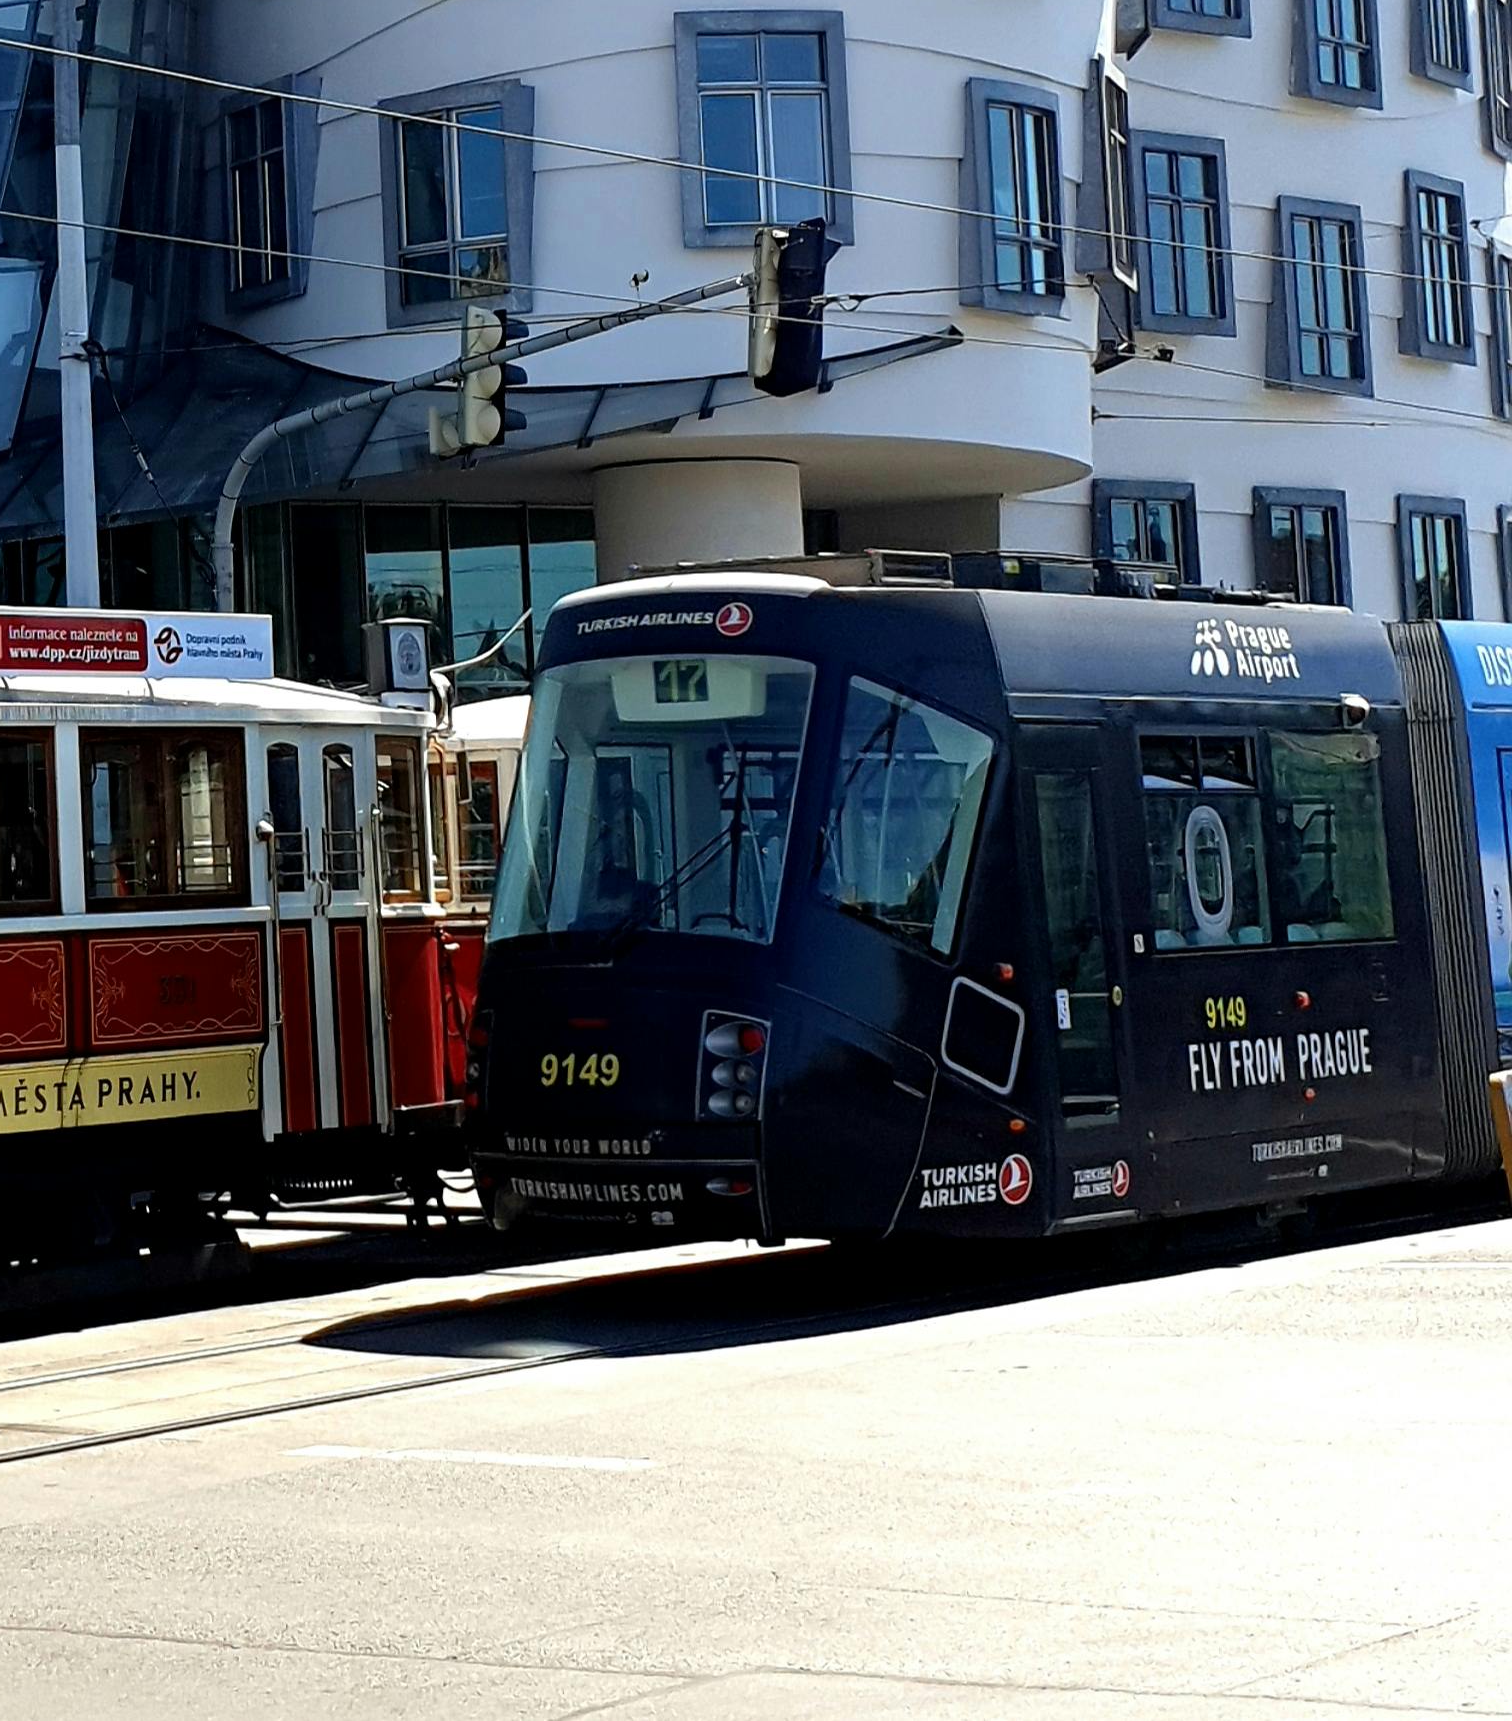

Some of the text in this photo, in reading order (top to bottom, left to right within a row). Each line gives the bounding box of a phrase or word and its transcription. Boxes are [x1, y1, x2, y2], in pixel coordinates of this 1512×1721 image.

[70, 627, 123, 642] naleznete
[125, 631, 139, 643] na
[576, 611, 715, 636] TURKISH AIRLINES
[221, 634, 246, 646] podnik
[1224, 619, 1292, 655] Prague
[9, 644, 140, 663] www.dpp.cz/jizdytram
[243, 648, 264, 662] Prahy
[1235, 648, 1301, 684] Airport
[658, 660, 705, 703] 17
[1204, 995, 1247, 1029] 9149
[540, 1052, 620, 1087] 9149
[1188, 1028, 1373, 1092] FLY FROM PRAGUE
[97, 1070, 202, 1109] PRAHY.
[553, 1138, 591, 1155] YOUR
[598, 1139, 652, 1155] WORLD
[920, 1162, 998, 1188] TURKISH
[510, 1177, 684, 1203] TURKISHAIRLINES.COM
[918, 1184, 998, 1210] AIRLINES
